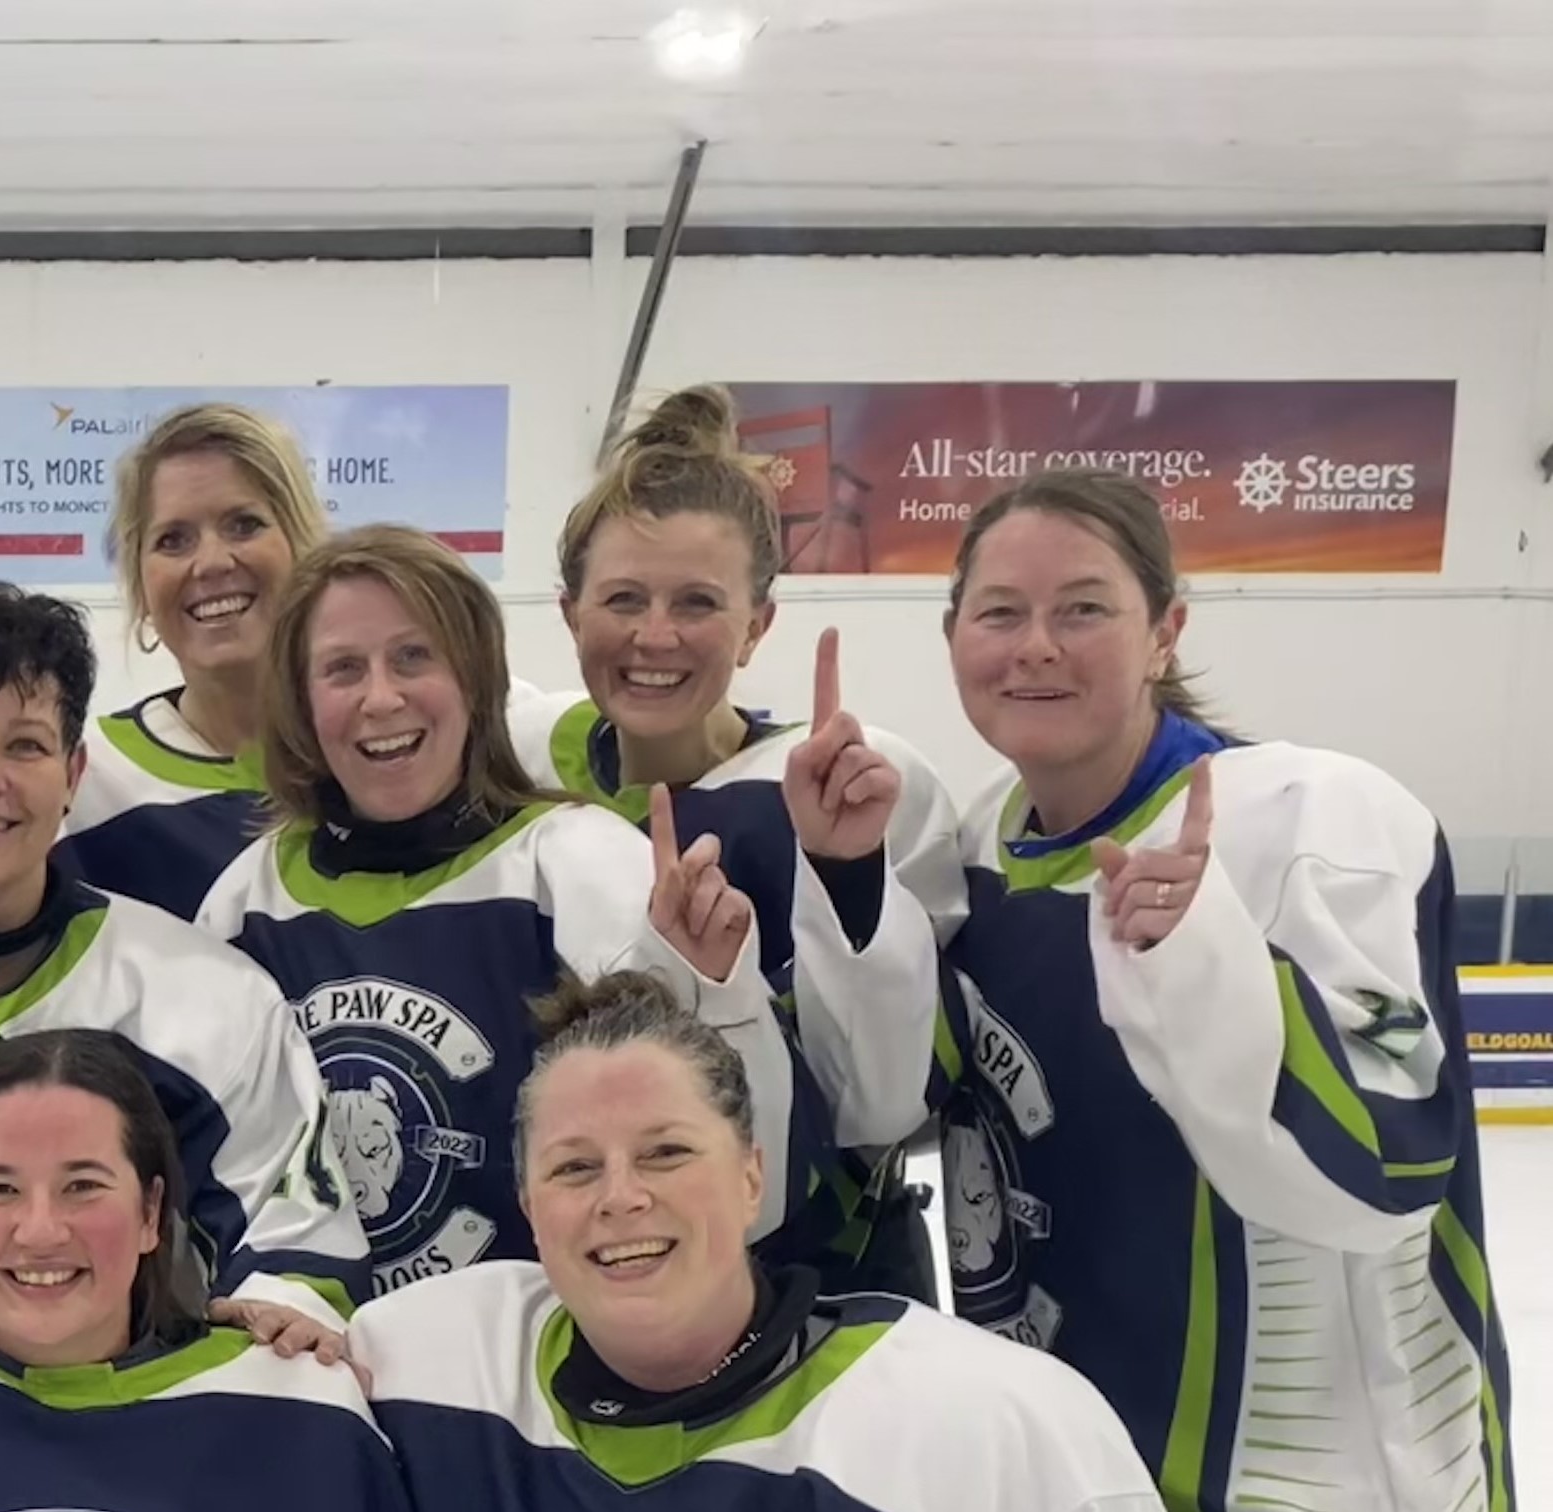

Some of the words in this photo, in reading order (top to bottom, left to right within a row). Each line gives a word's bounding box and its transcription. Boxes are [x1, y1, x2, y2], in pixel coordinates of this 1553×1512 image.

[70, 413, 149, 435] PALair
[45, 457, 106, 486] MORE
[326, 456, 395, 485] HOME.
[899, 438, 1036, 478] All-star
[1295, 454, 1416, 491] Steers
[30, 500, 50, 514] TO
[899, 498, 972, 522] Home
[1293, 491, 1415, 513] insurance
[329, 986, 394, 1021] PAW
[394, 997, 456, 1050] SPA
[978, 1030, 1025, 1097] SPA
[428, 1130, 474, 1156] 2022
